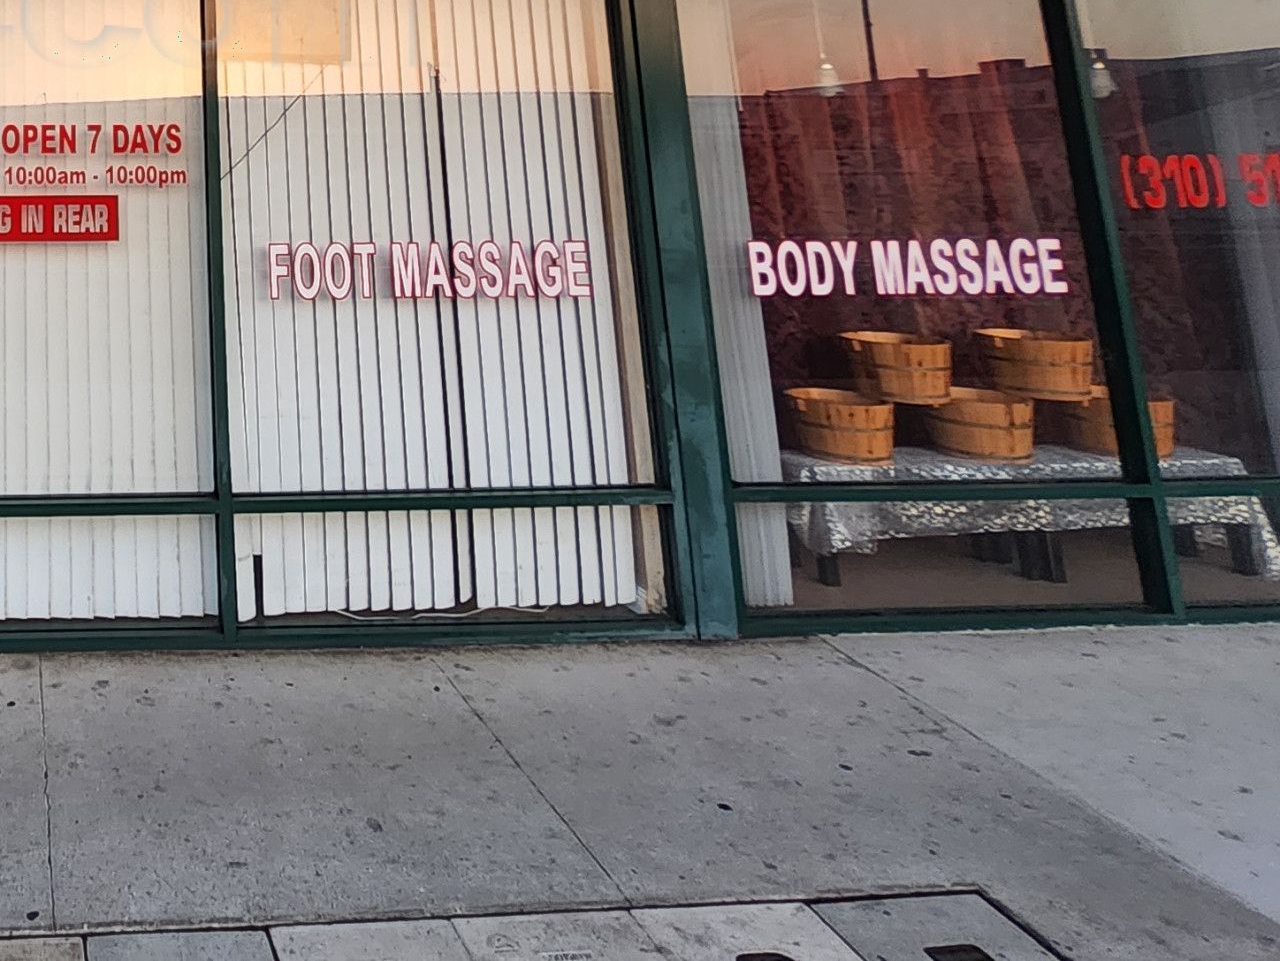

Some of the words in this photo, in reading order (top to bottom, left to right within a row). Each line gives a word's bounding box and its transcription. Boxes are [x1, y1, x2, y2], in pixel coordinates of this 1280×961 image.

[1, 125, 76, 154] OPEN
[87, 125, 102, 154] 7
[112, 125, 182, 154] DAYS
[4, 166, 86, 185] 10:00am
[105, 166, 187, 188] 10:00pm
[1120, 153, 1227, 209] (310)
[21, 205, 43, 233] IN
[53, 204, 108, 233] REAR
[269, 242, 376, 300] FOOT
[391, 240, 594, 300] MASSAGE
[748, 241, 858, 296] BODY
[870, 238, 1068, 295] MASSAGE
